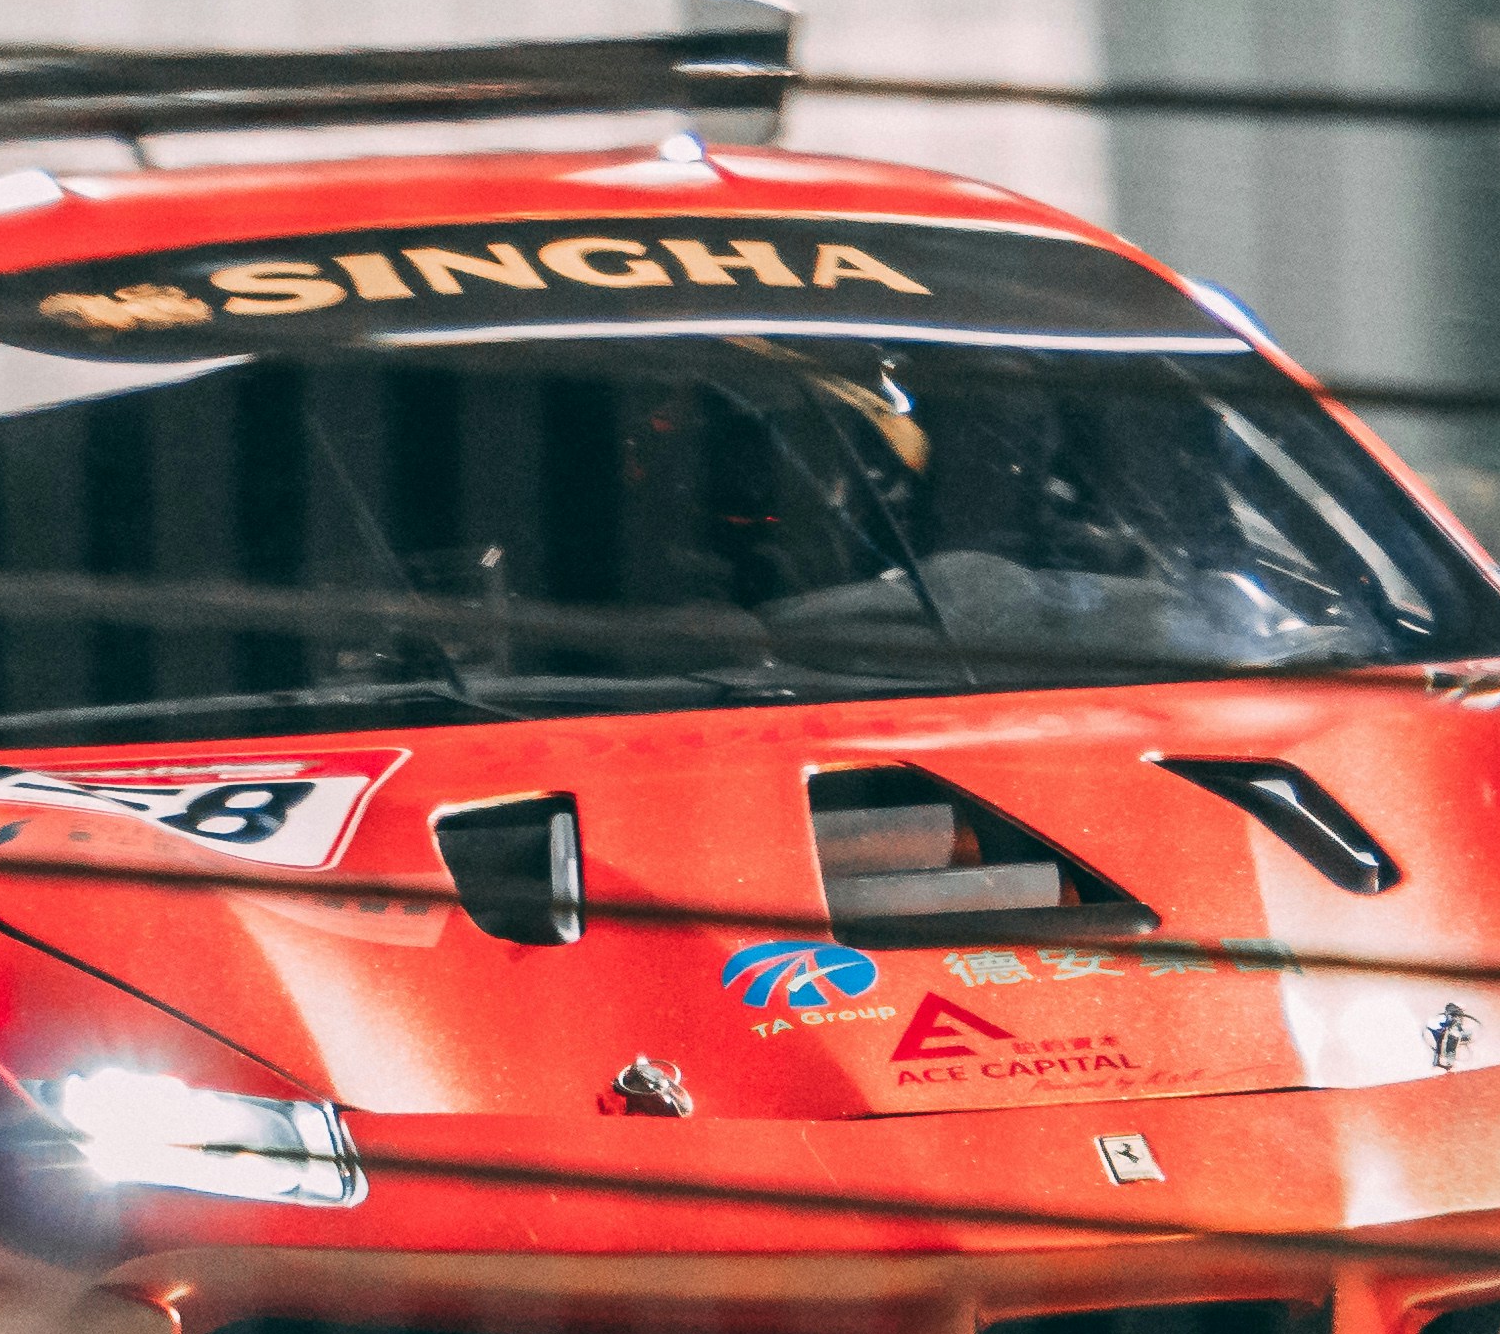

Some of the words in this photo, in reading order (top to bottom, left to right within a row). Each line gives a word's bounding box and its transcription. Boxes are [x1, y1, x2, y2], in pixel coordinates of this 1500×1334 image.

[210, 236, 933, 317] SINGHA
[751, 1018, 794, 1039] TA
[800, 1005, 897, 1025] Group
[897, 1066, 968, 1086] ACE
[980, 1052, 1142, 1079] CAPITAL
